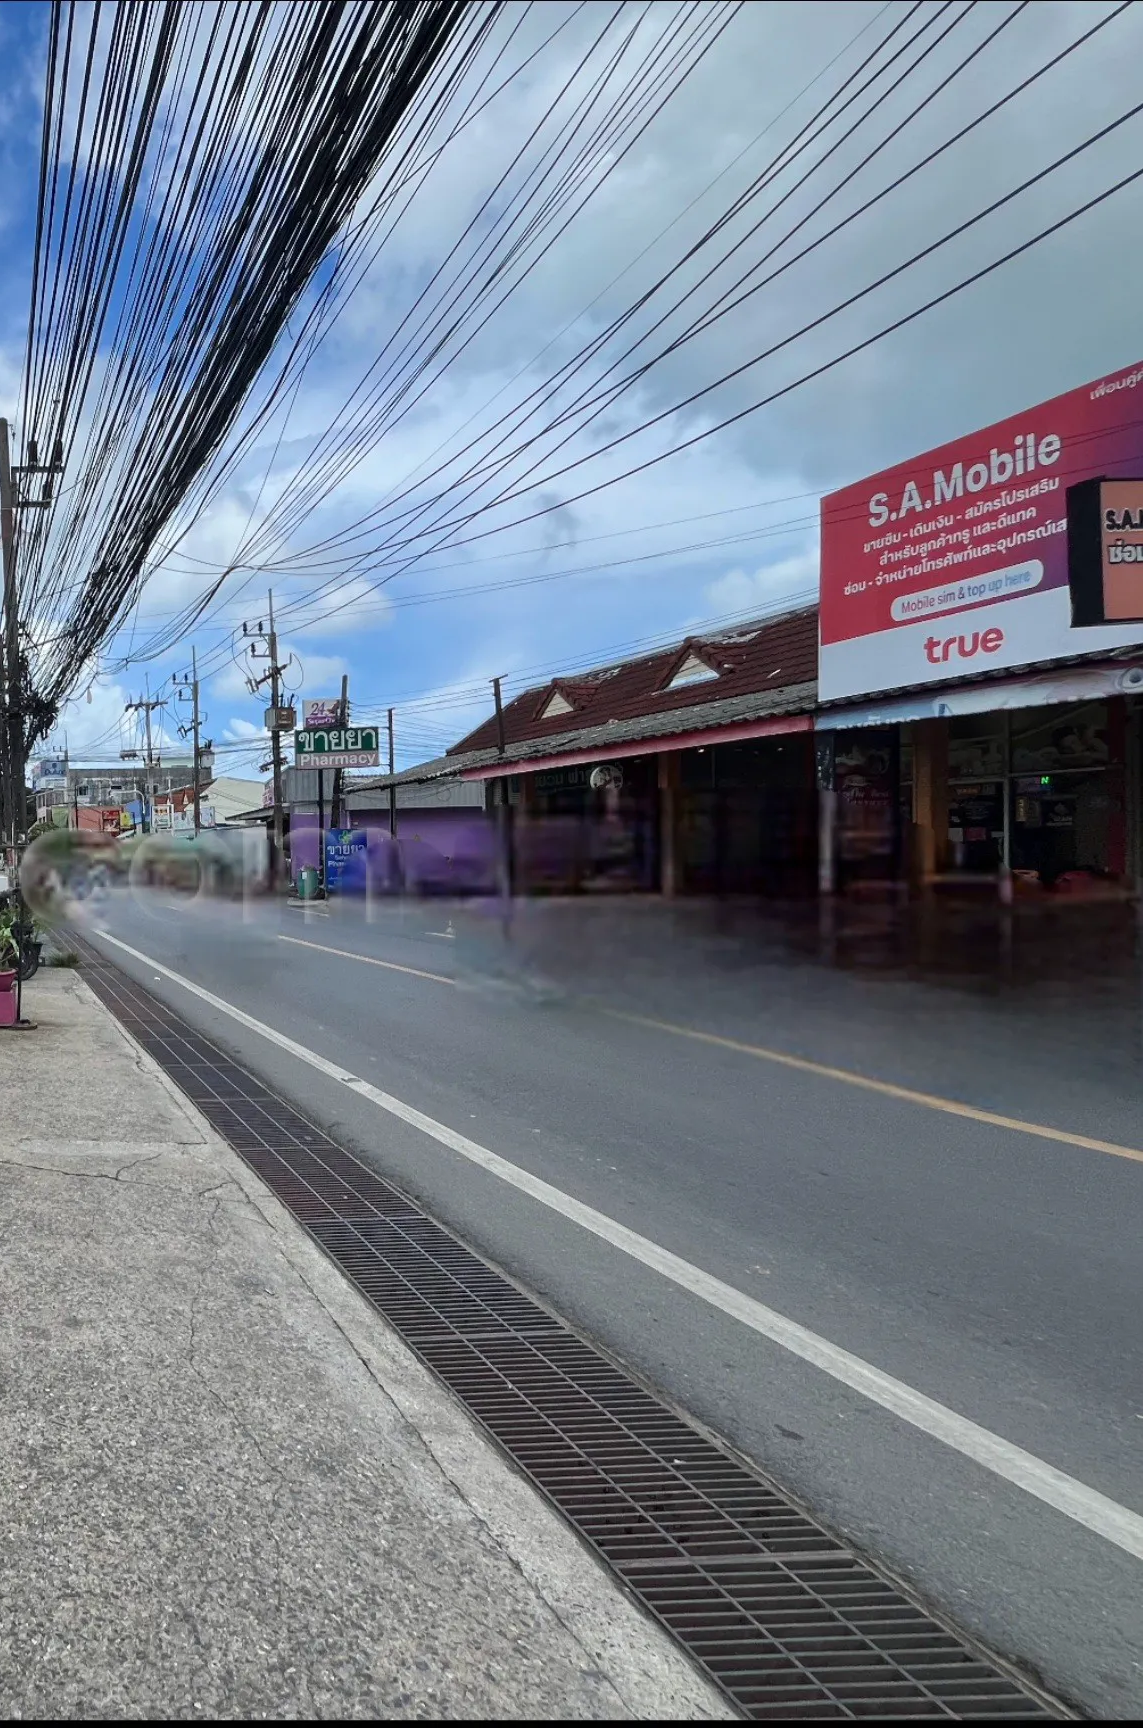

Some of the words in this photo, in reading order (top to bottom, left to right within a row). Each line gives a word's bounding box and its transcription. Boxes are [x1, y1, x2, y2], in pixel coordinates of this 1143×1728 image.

[869, 433, 1061, 527] S.A.Mobile
[909, 514, 954, 540] เติมเงิน
[900, 595, 935, 614] Mobile
[936, 591, 956, 606] sim
[957, 587, 966, 601] &
[966, 583, 987, 602] top
[987, 578, 1004, 597] up
[1004, 571, 1032, 588] here
[924, 627, 1004, 665] true
[298, 729, 377, 752] ขายยา
[300, 753, 376, 767] Pharmacy
